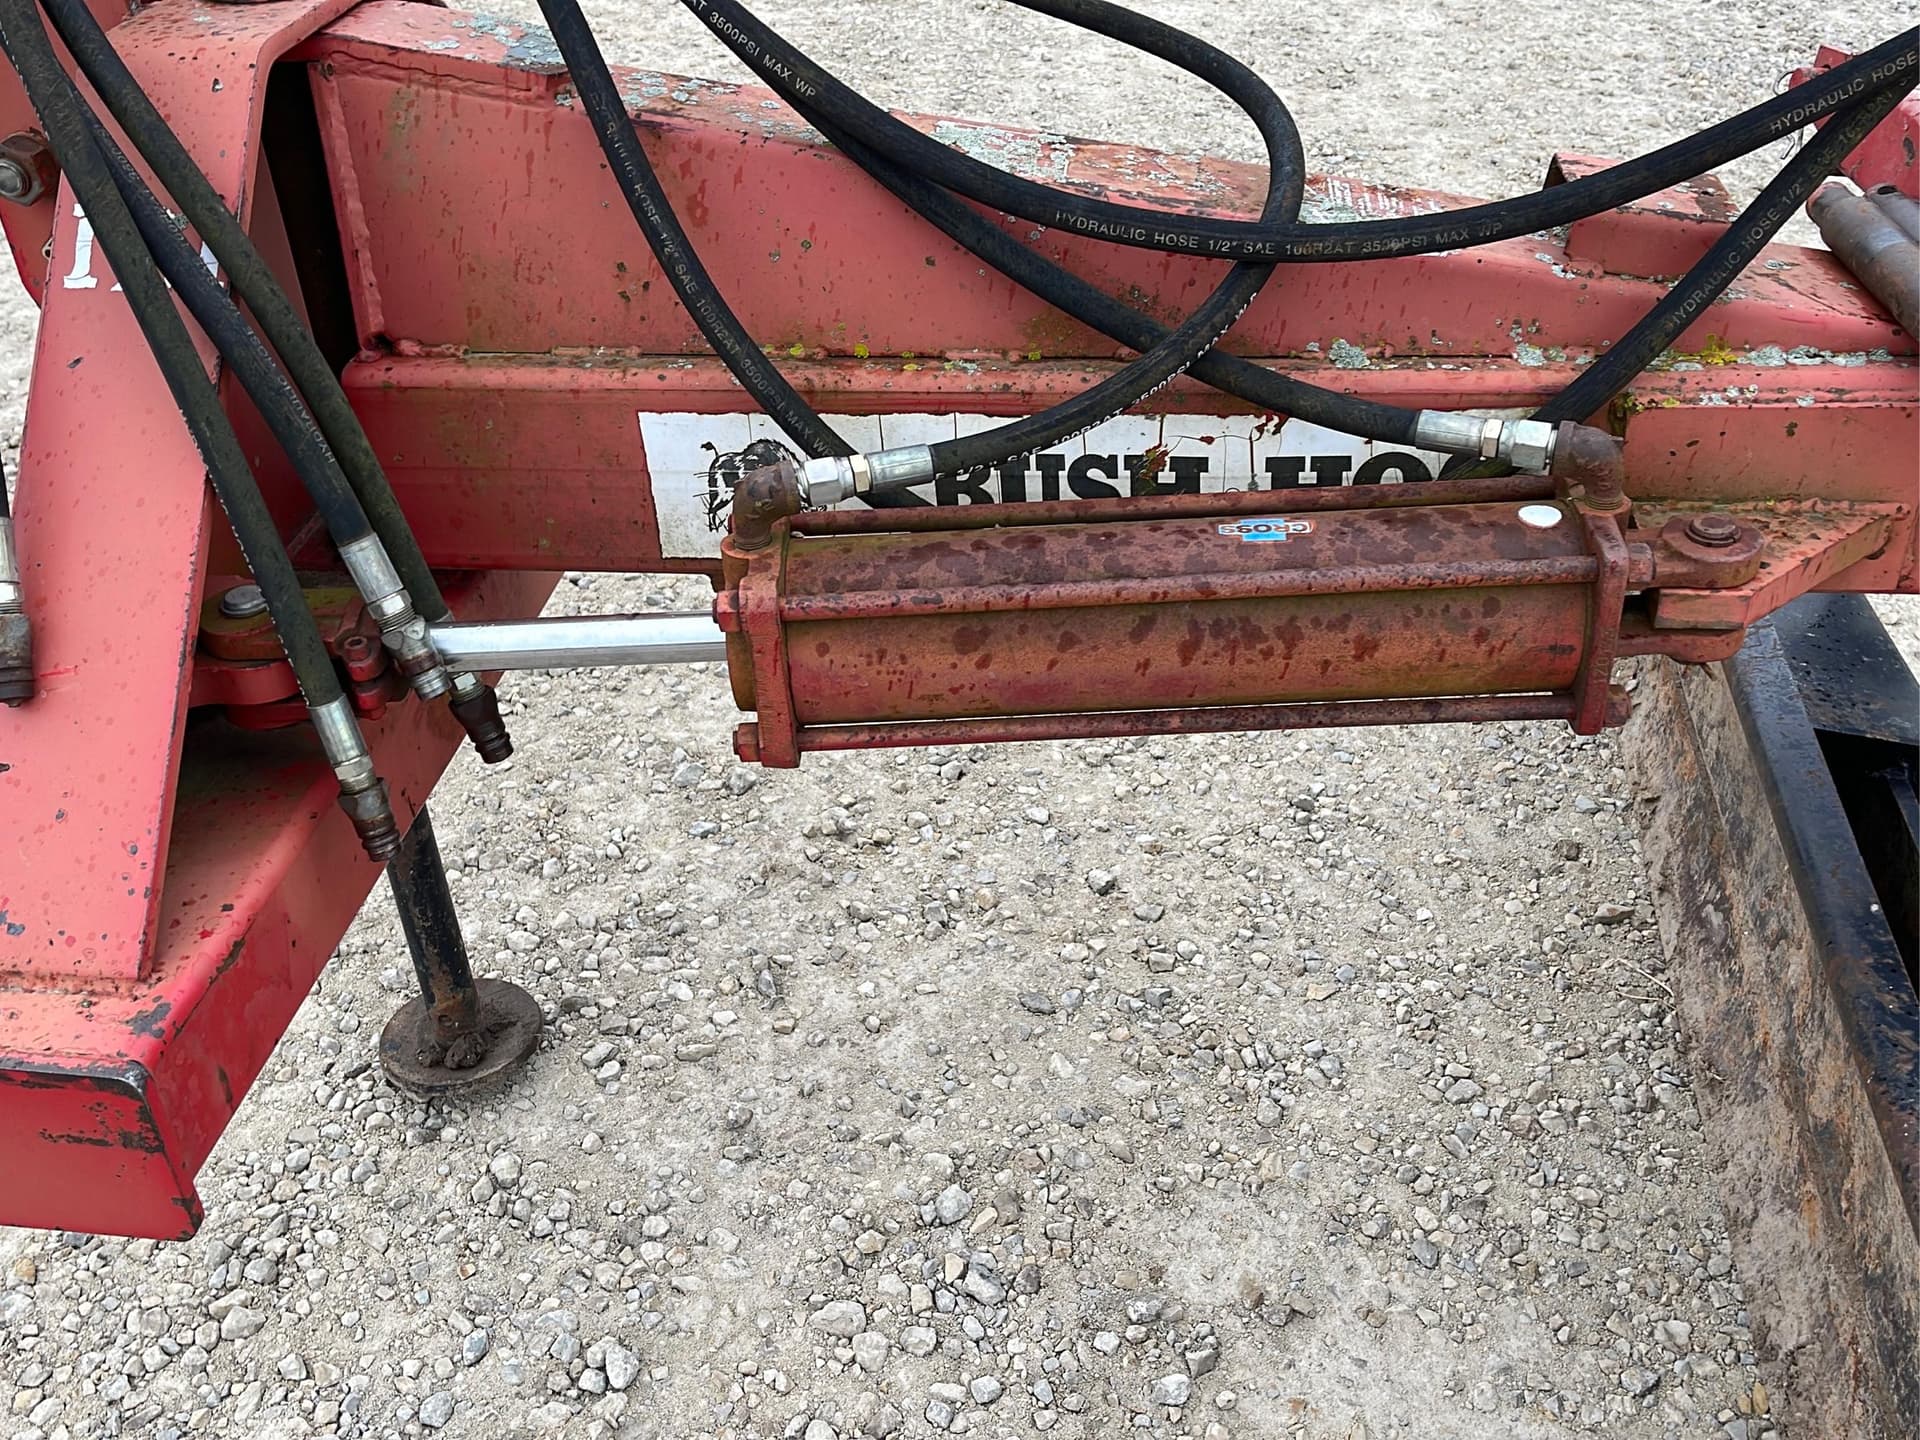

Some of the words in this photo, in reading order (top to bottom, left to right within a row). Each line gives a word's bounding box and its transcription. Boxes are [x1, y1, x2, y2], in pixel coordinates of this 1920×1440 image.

[709, 11, 761, 57] 3500PSI
[762, 54, 793, 82] MAX
[795, 77, 817, 98] WP
[1768, 77, 1866, 134] HYDRAULIC
[1871, 50, 1919, 84] HOSE
[1055, 210, 1147, 241] HYDRAULIC
[1154, 232, 1200, 249] HOSE
[1243, 241, 1276, 255] SAE
[1434, 226, 1471, 246] MAX
[1665, 253, 1742, 328] HYDRAULIC
[1741, 206, 1783, 249] HOSE
[674, 263, 700, 295] SAE
[784, 409, 812, 440] MAX
[935, 454, 1209, 507] BUSH
[1221, 522, 1309, 534] CROSS
